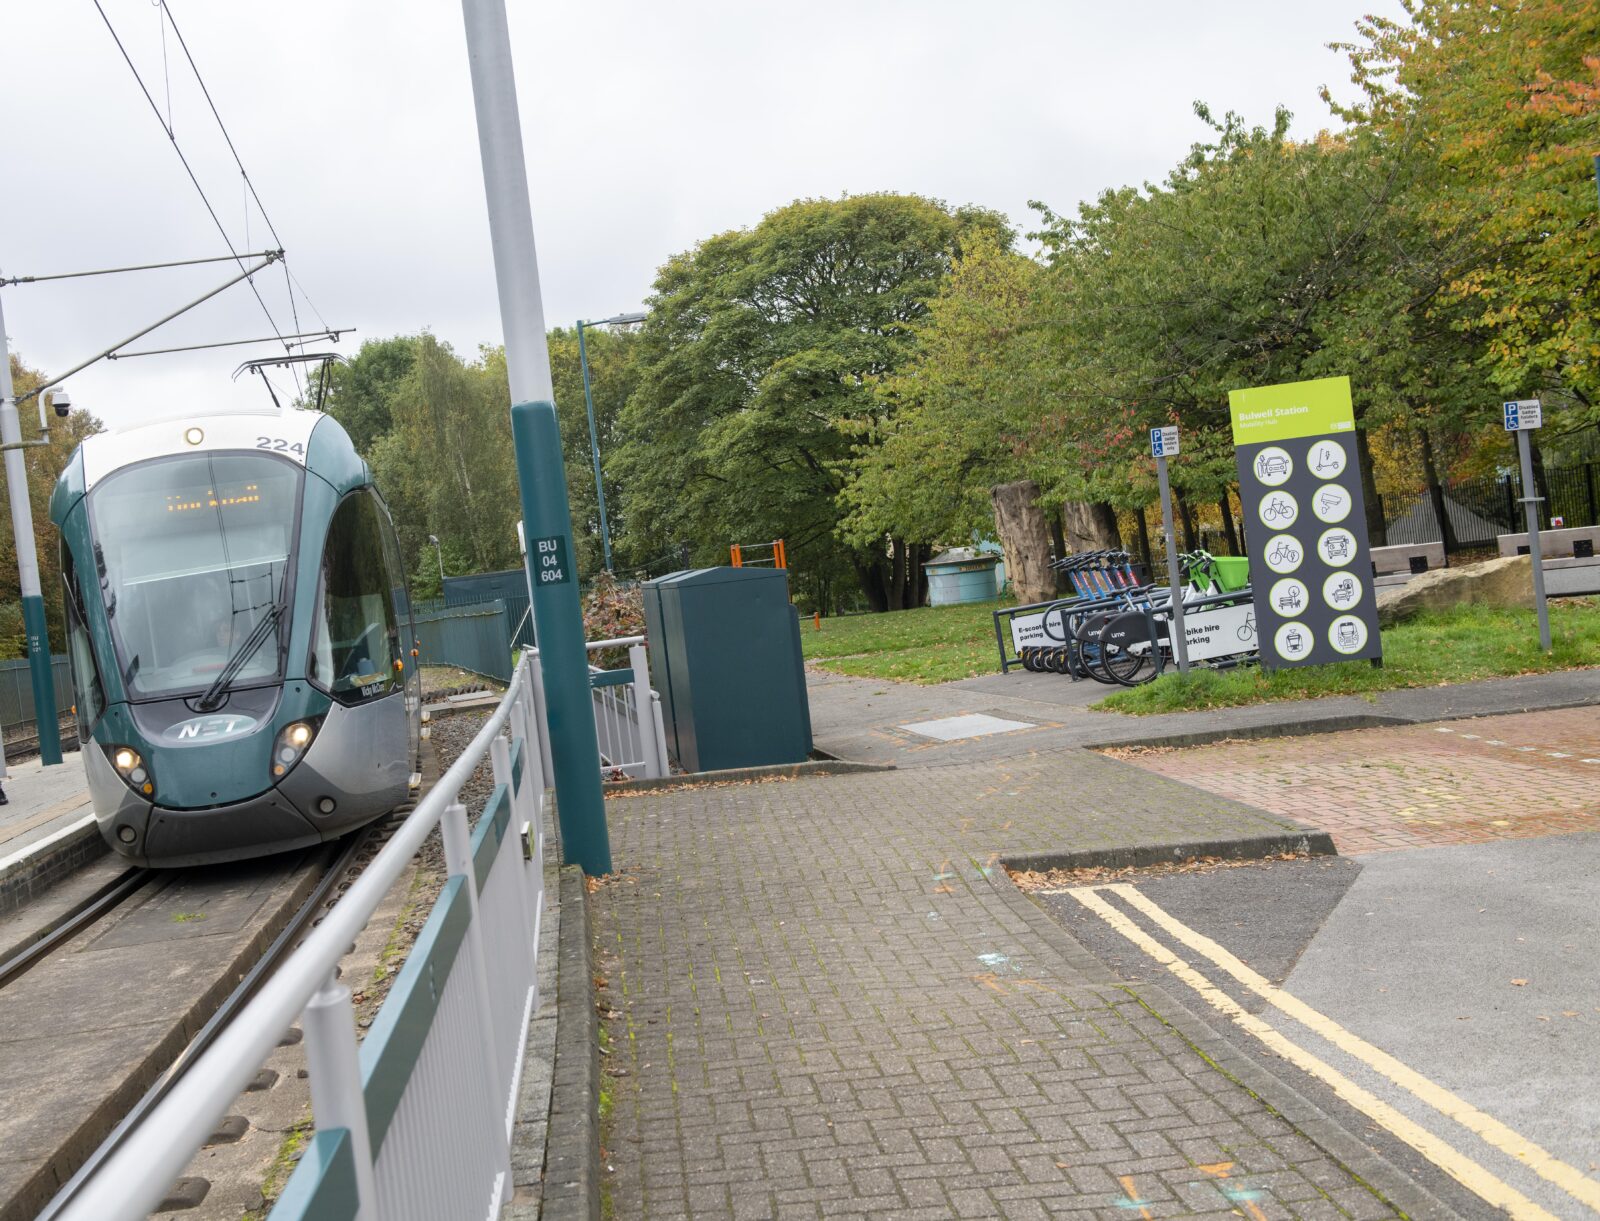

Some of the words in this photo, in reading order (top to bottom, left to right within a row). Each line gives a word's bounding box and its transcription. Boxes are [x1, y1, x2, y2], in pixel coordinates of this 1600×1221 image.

[1239, 409, 1273, 421] Bulwell
[1275, 406, 1309, 417] Station
[1509, 404, 1516, 415] P
[1154, 430, 1161, 442] P
[256, 436, 305, 456] 224
[538, 539, 558, 553] BU
[542, 554, 558, 567] 04
[541, 568, 564, 582] 604
[1049, 620, 1062, 628] hire
[1204, 624, 1220, 633] hire
[1019, 632, 1044, 643] parking
[1186, 636, 1211, 646] arking
[178, 719, 243, 739] NET
